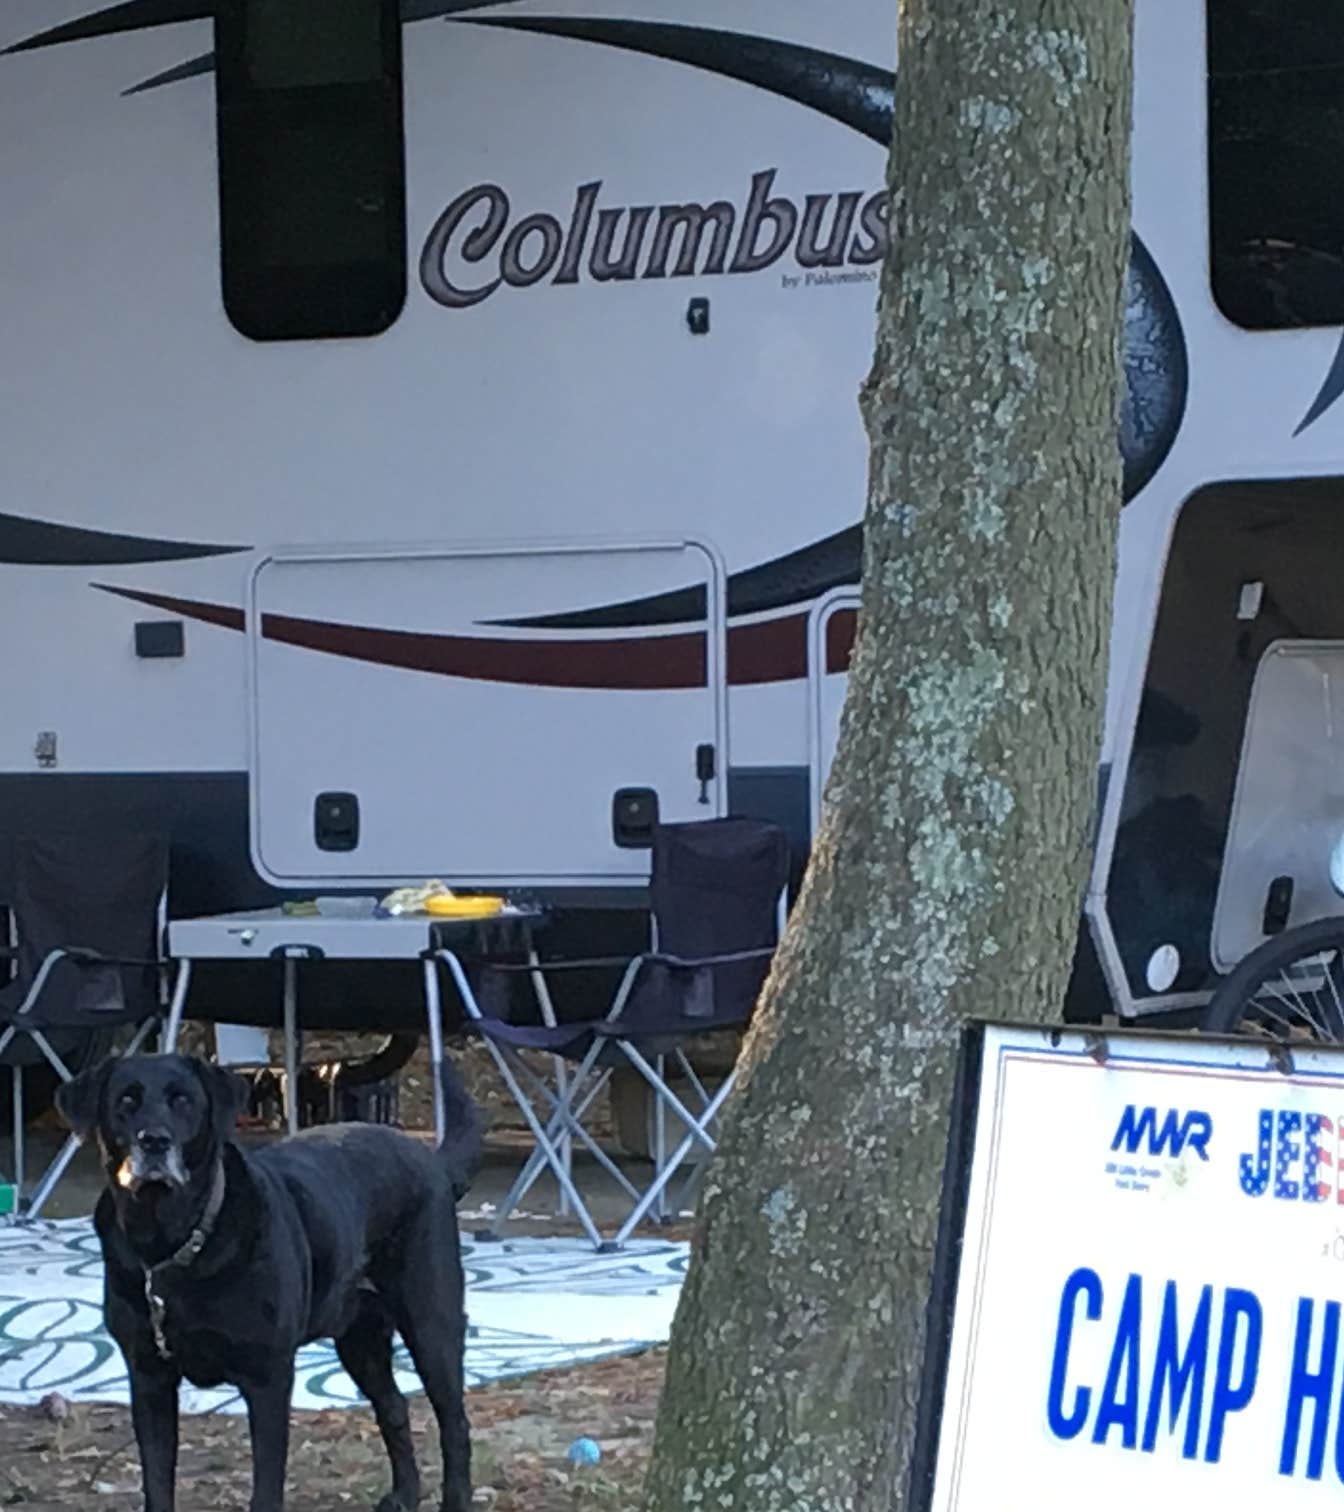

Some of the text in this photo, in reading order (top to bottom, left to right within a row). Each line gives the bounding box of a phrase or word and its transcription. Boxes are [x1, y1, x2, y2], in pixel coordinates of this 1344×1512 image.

[419, 167, 890, 308] Columbus
[1110, 1103, 1213, 1162] MWR
[1046, 1267, 1263, 1464] CAMP
